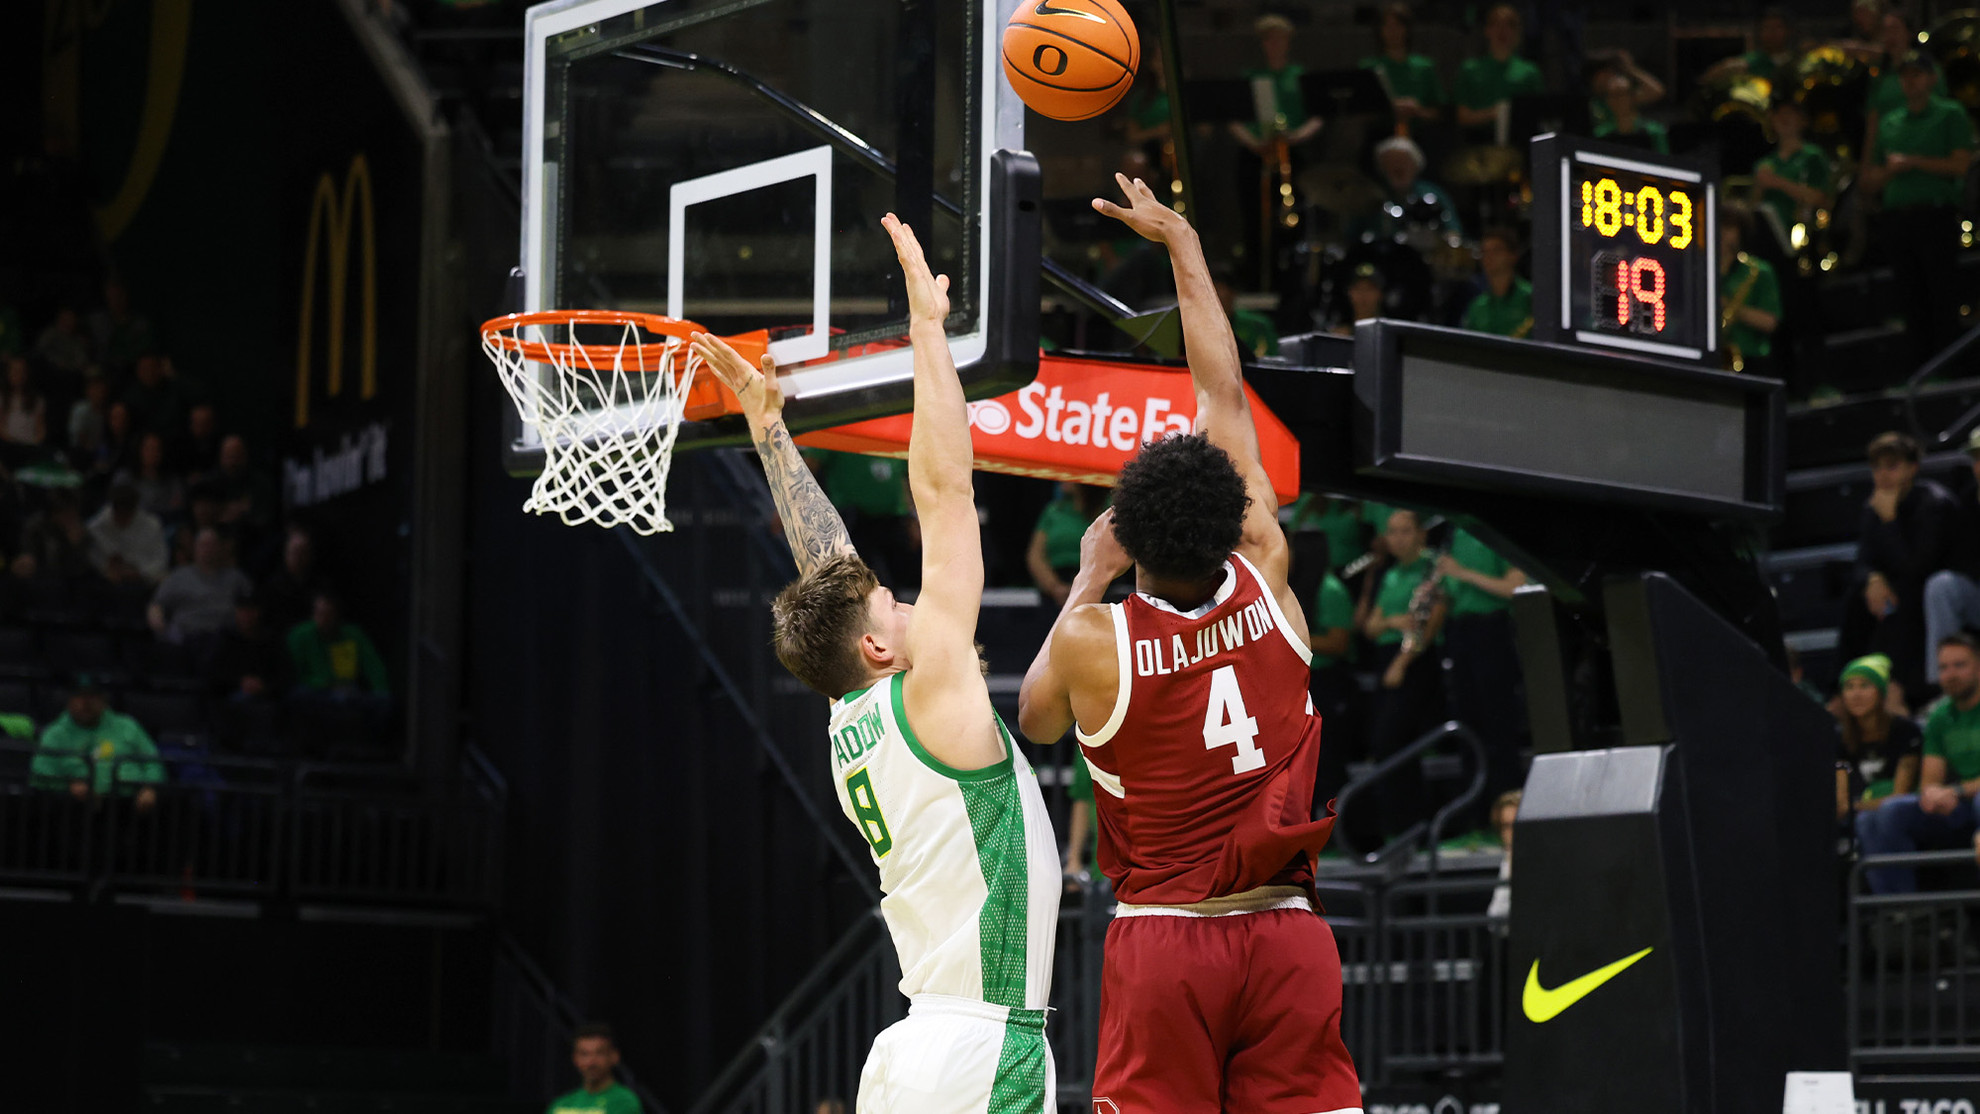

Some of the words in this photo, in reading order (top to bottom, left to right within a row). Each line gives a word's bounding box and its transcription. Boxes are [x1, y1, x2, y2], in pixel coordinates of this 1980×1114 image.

[1582, 177, 1693, 250] 18:03
[1617, 256, 1666, 332] 19
[1015, 381, 1139, 451] State
[1140, 397, 1198, 449] Fa
[1135, 595, 1274, 677] OLAJUWON
[1202, 664, 1267, 775] 4
[846, 765, 893, 859] 8
